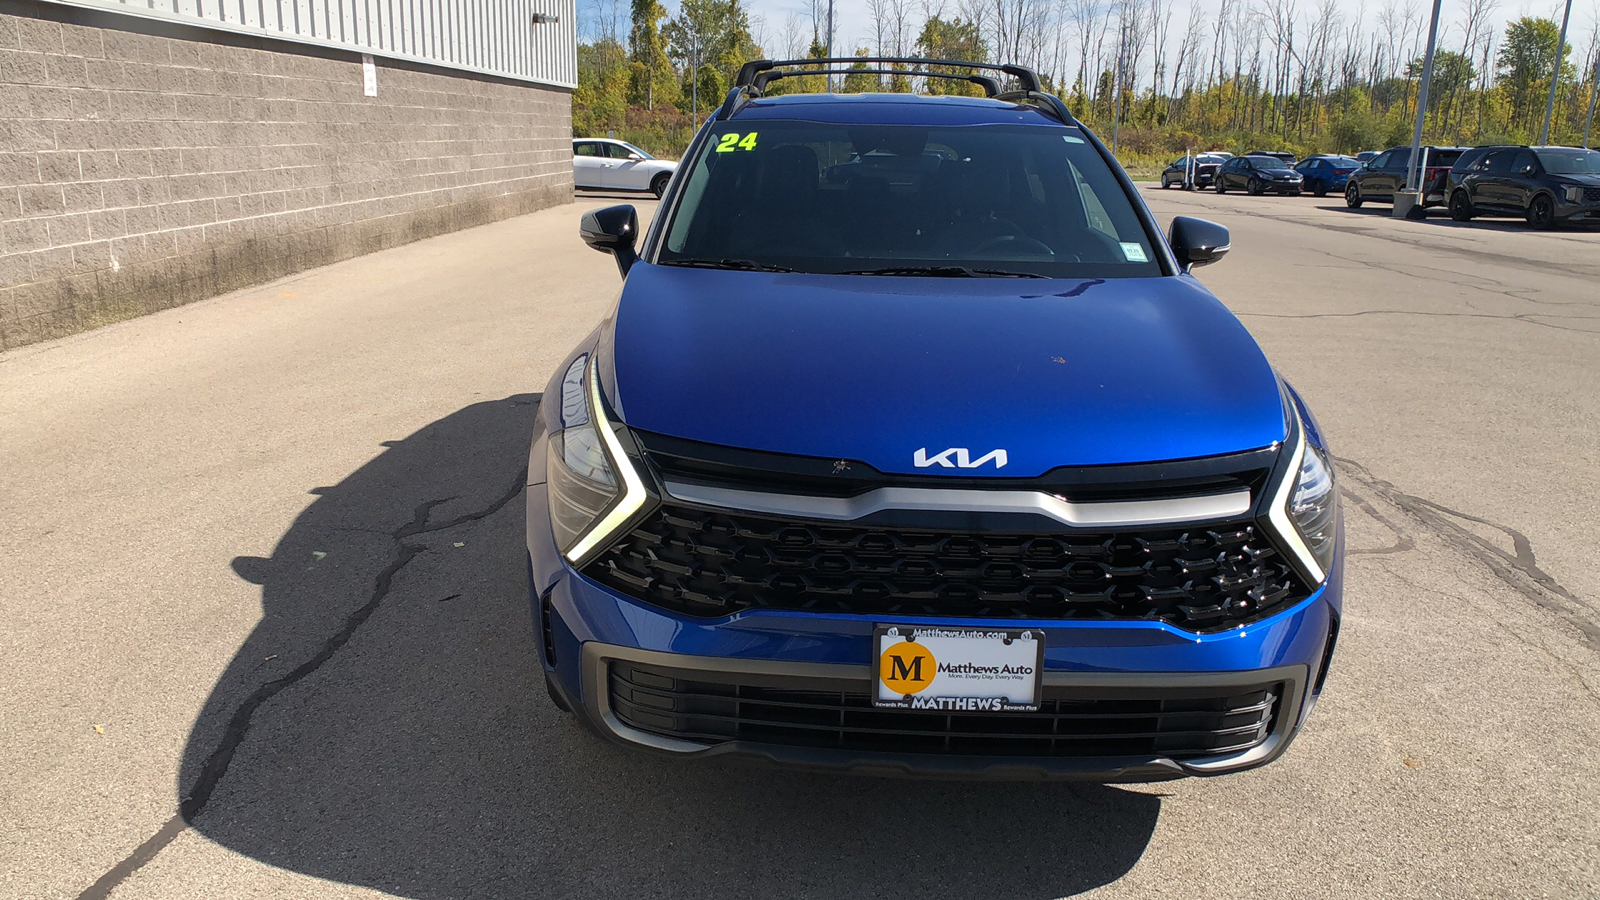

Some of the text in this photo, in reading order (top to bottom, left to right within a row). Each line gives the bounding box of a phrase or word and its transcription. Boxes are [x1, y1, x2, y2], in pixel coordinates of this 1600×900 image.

[716, 132, 758, 152] 24
[913, 447, 1008, 469] KIA
[912, 628, 1008, 640] MatthewsAuto.com
[887, 655, 926, 682] M
[937, 661, 1033, 675] Matthews Auto
[911, 697, 1002, 711] MATTHEWS
